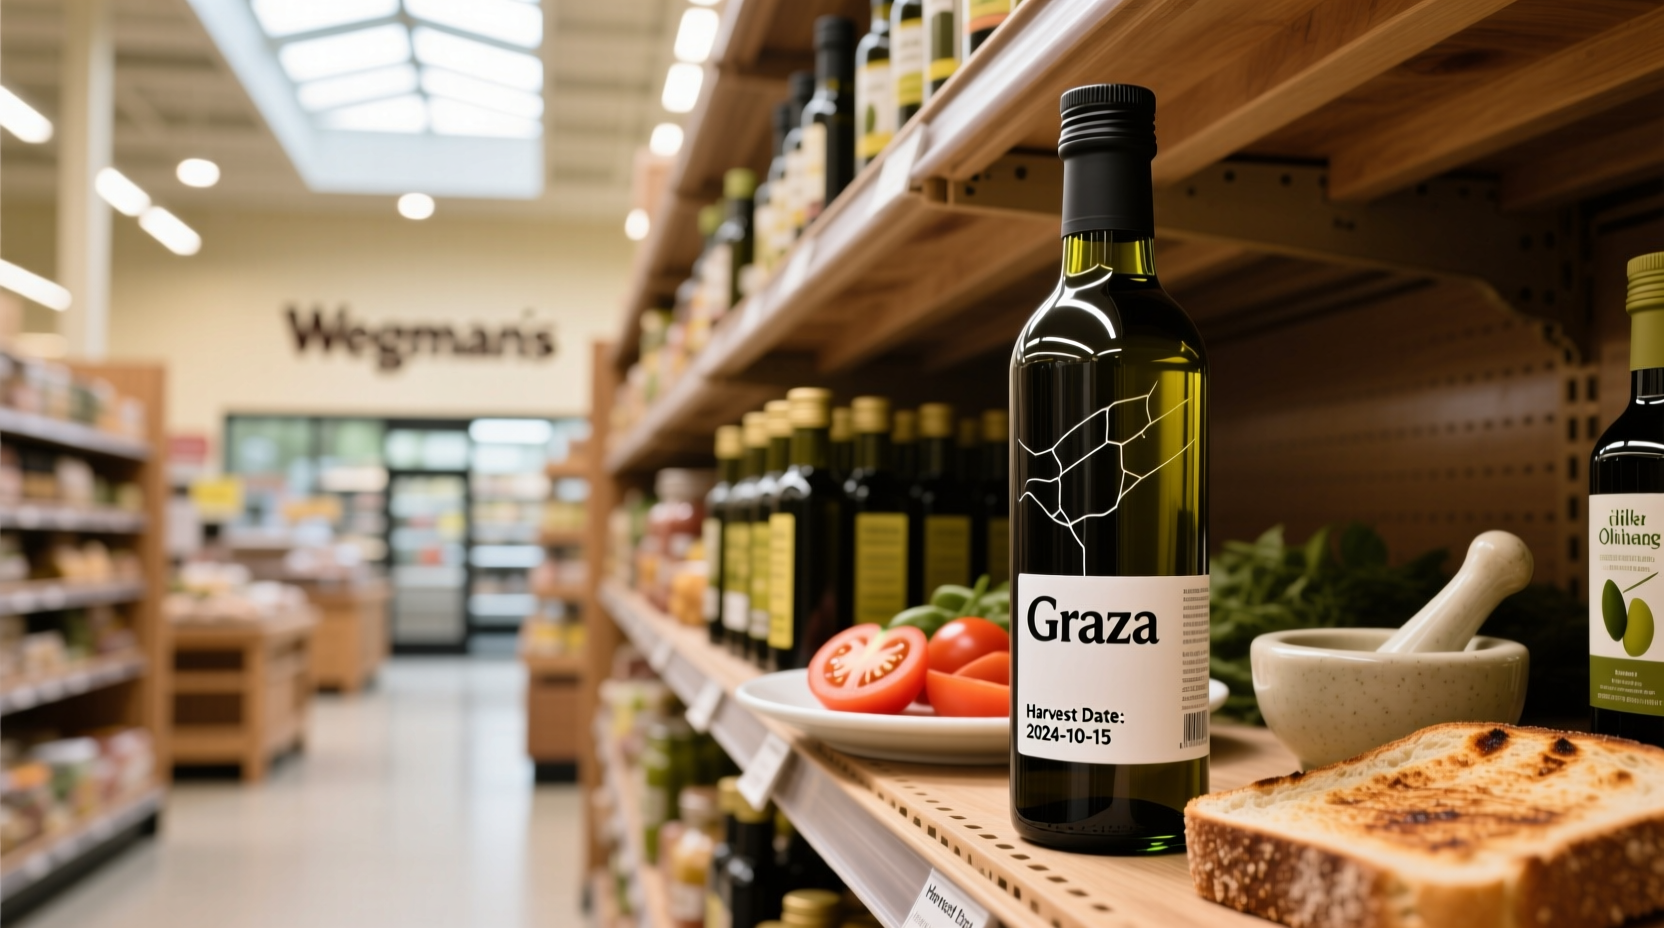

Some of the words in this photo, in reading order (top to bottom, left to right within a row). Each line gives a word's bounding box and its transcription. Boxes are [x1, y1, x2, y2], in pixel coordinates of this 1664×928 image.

[1027, 595, 1160, 645] Graza
[1026, 703, 1078, 723] Harvest
[1081, 707, 1125, 725] Date:
[1026, 723, 1112, 745] 2024-10-15
